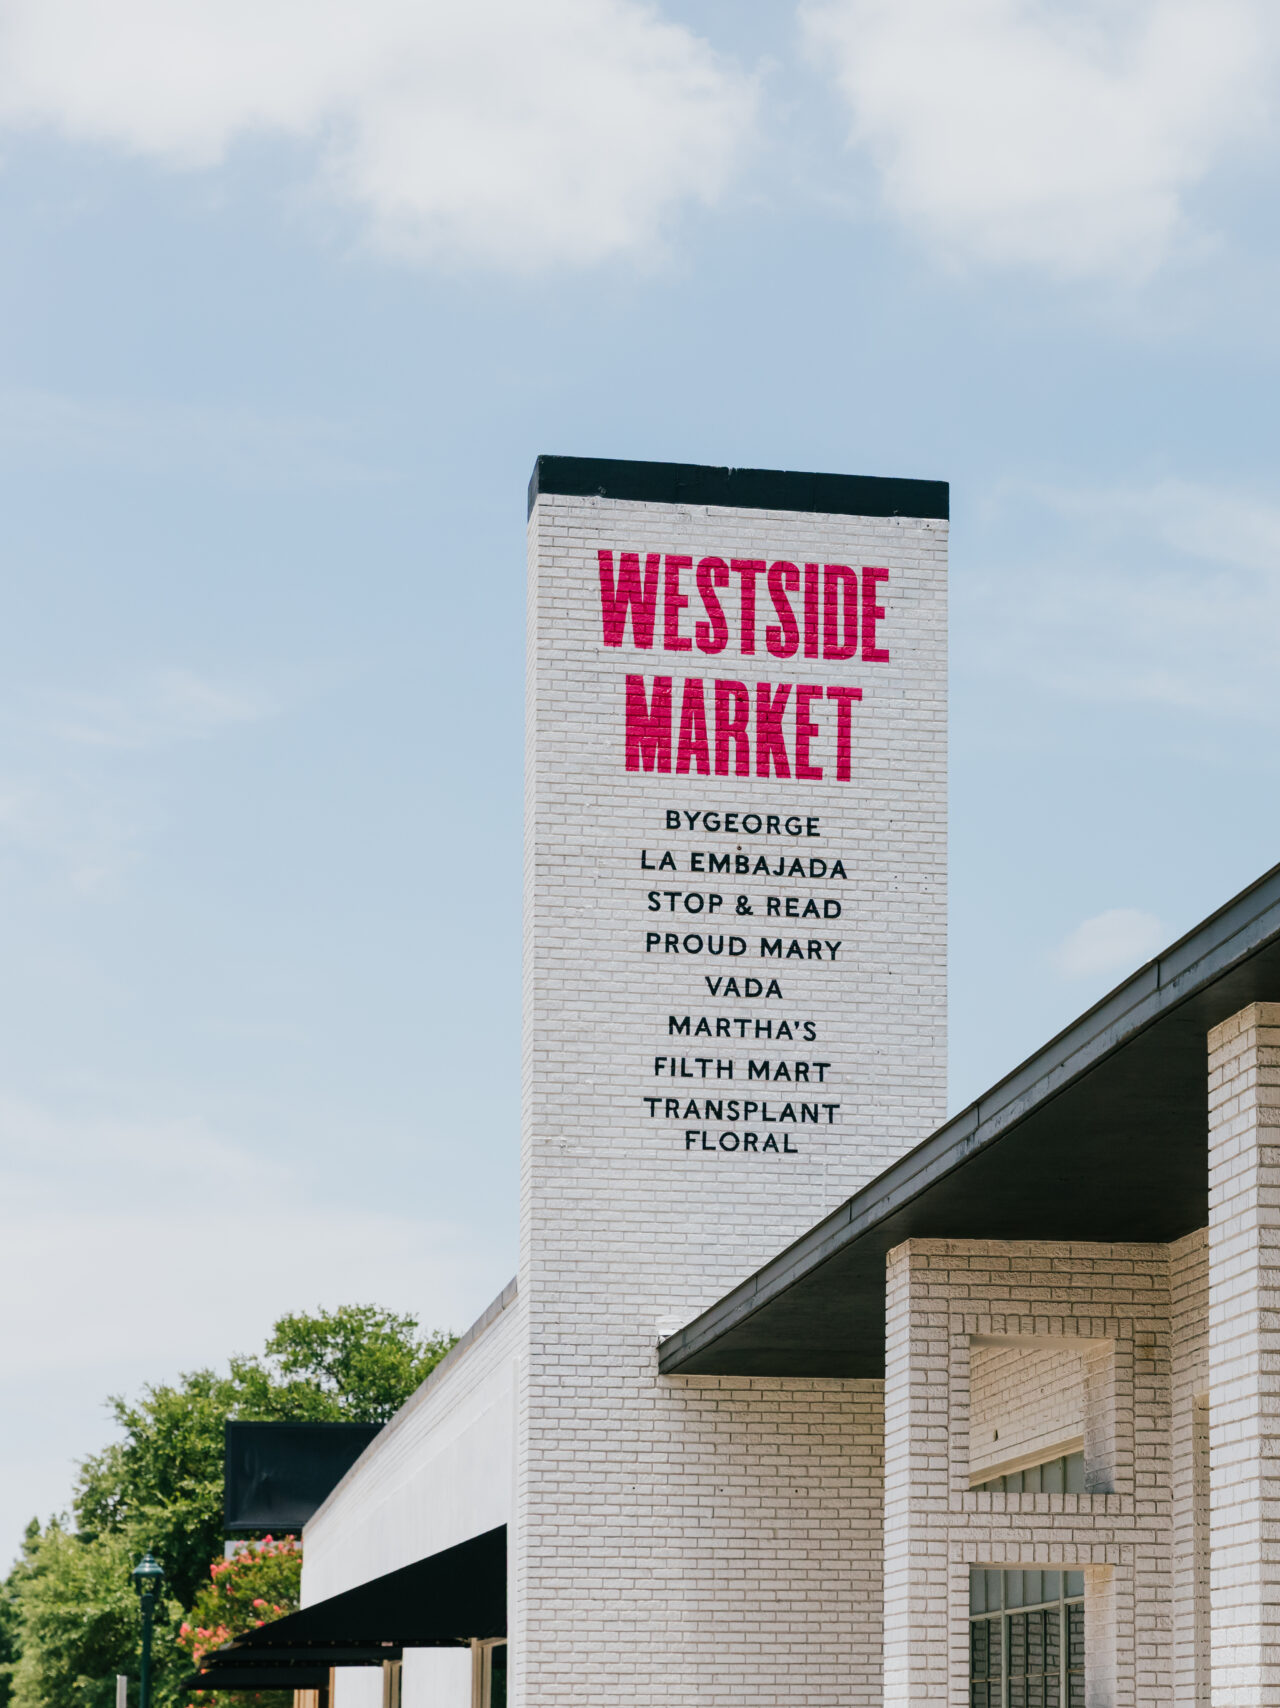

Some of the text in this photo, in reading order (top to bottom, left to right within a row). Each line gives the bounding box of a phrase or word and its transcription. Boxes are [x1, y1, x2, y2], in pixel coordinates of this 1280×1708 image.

[598, 550, 890, 663] WESTSIDE
[625, 674, 863, 782] MARKET
[665, 809, 821, 837] BYGEORGE
[640, 849, 848, 880] LA EMBAJADA
[647, 890, 842, 920] STOP & READ
[646, 932, 842, 961] PROUD MARY
[704, 975, 783, 999] VADA
[668, 1015, 817, 1042] MARTHA'S
[654, 1056, 832, 1083] FILTH MART
[643, 1097, 841, 1125] TRANSPLANT
[685, 1129, 799, 1154] FLORAL
